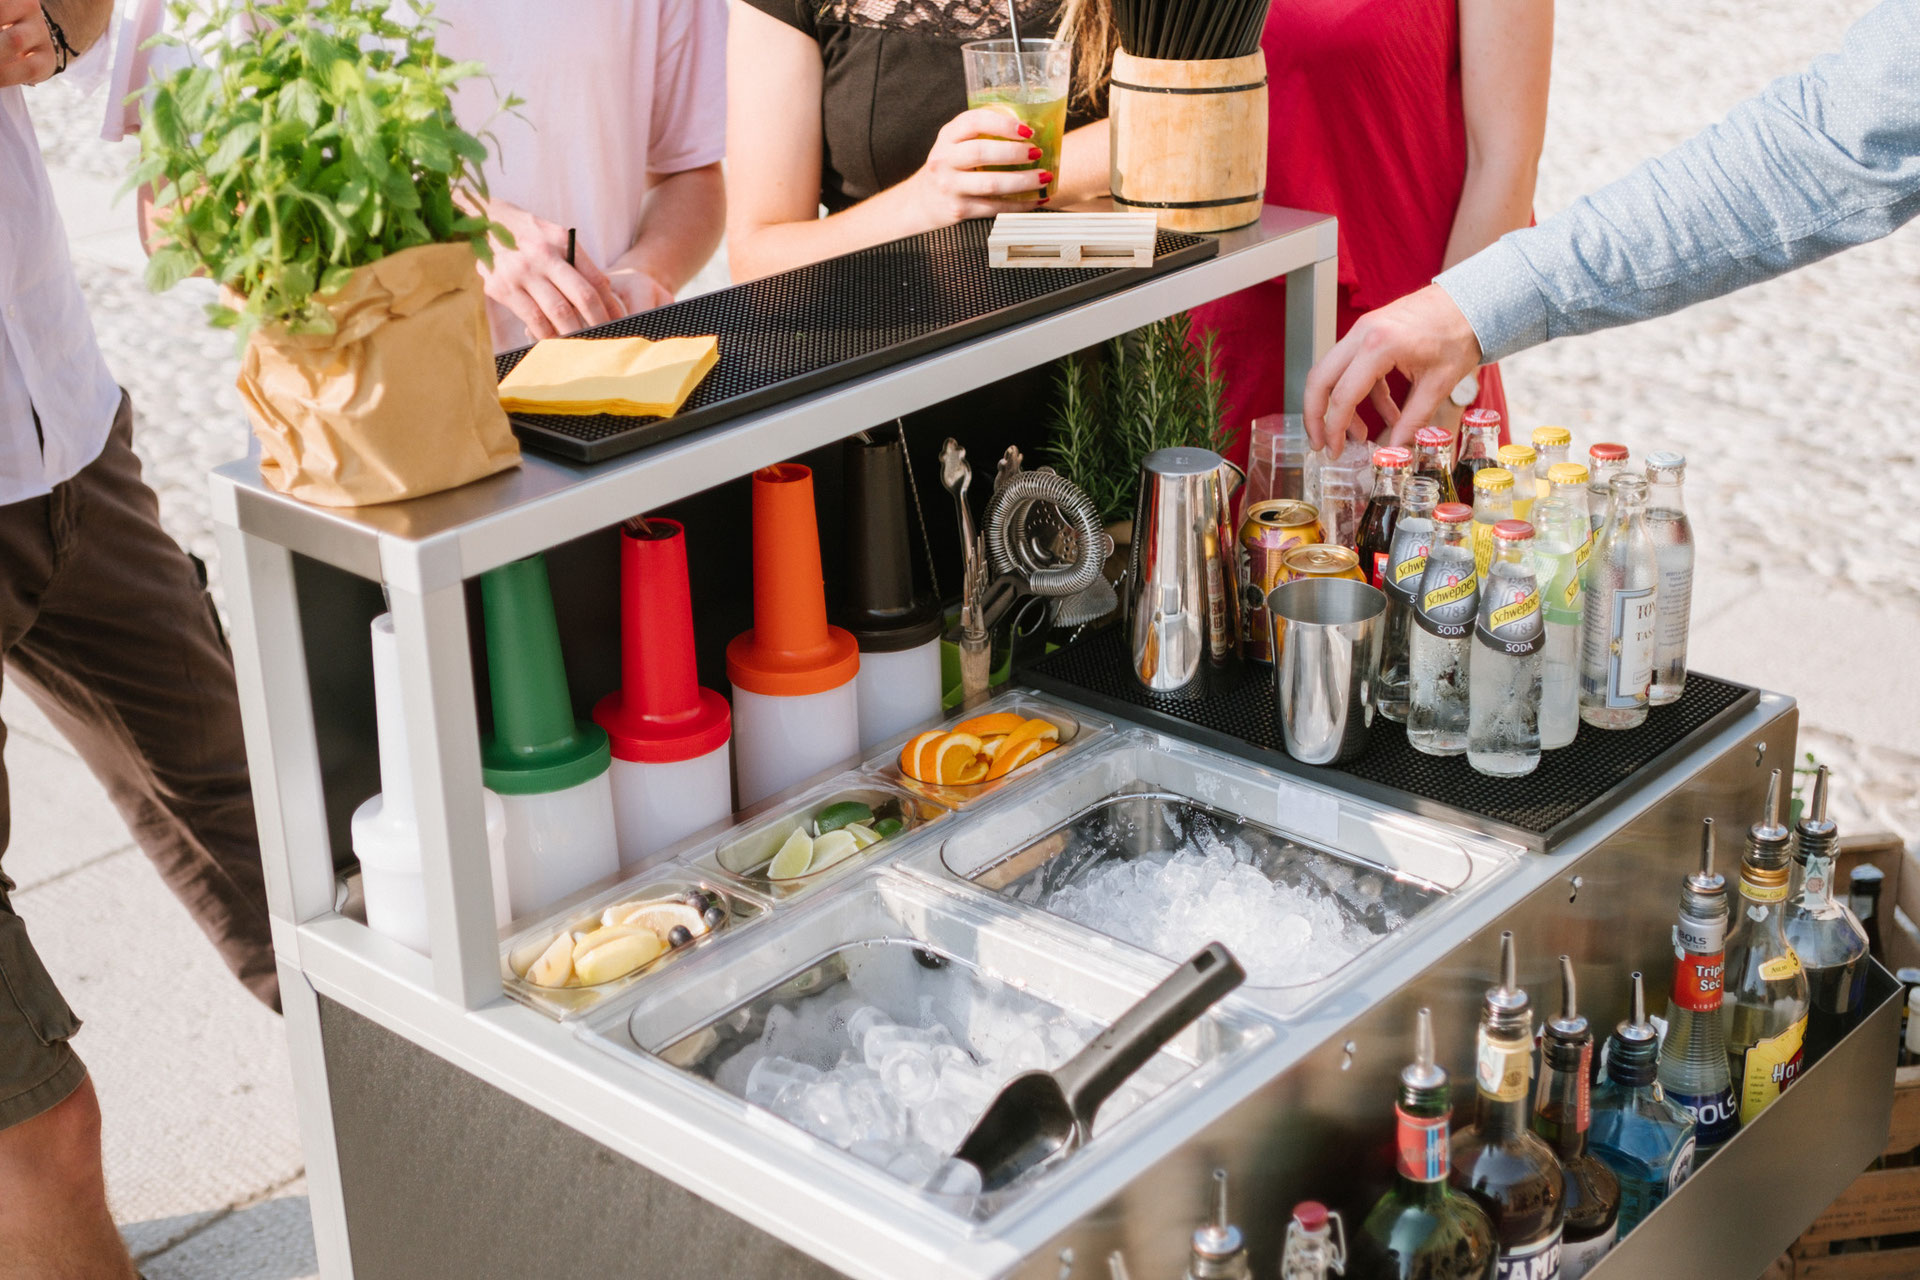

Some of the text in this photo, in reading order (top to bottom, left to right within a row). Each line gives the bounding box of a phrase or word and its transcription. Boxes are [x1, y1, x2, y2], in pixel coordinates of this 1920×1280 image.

[1427, 576, 1475, 607] Schweppes
[1441, 605, 1467, 619] 1783
[1437, 625, 1466, 636] SODA
[1508, 621, 1534, 635] 1783
[1505, 642, 1534, 653] SODA
[1679, 929, 1707, 945] BOLS
[1700, 979, 1721, 992] Sec
[1773, 1058, 1803, 1083] Hav
[1496, 1244, 1561, 1280] CAMP
